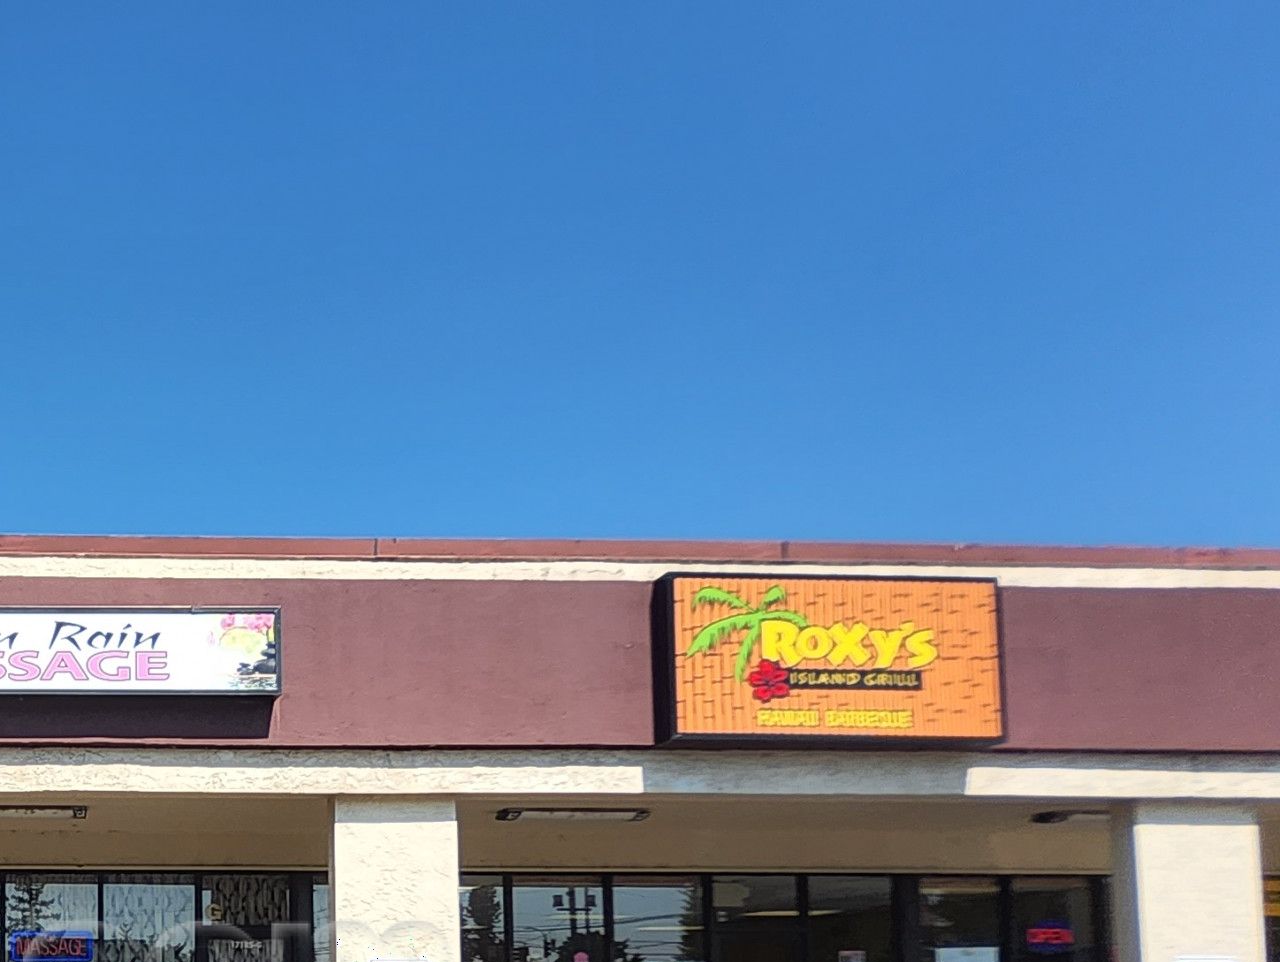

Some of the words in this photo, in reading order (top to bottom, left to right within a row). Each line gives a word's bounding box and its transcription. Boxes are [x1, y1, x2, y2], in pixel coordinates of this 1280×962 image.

[49, 621, 161, 649] Rain
[789, 671, 860, 686] ISLAND
[864, 673, 919, 687] GRILL
[16, 936, 87, 956] MASSAGE
